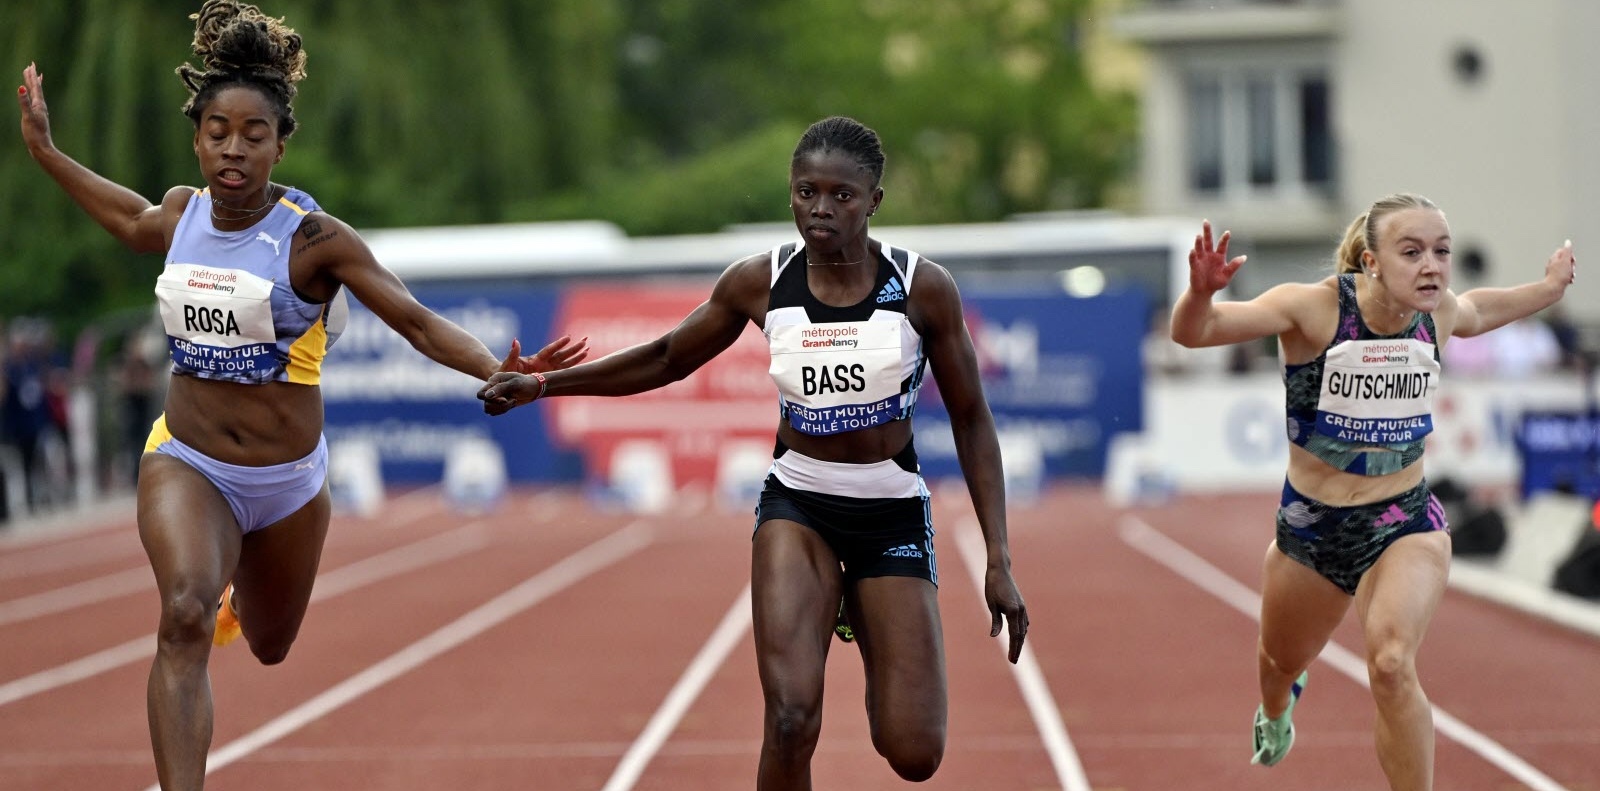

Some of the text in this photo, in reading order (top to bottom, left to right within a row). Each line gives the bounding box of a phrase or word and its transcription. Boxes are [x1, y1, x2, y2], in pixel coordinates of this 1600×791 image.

[190, 270, 237, 283] métropole
[188, 279, 236, 294] GrandNancy
[184, 304, 241, 337] ROSA
[801, 326, 858, 340] métropole
[175, 339, 270, 360] CRÉDIT MUTUEL
[802, 338, 859, 348] GrandNancy
[1363, 343, 1409, 354] métropole
[183, 356, 255, 371] ATHLÉ TOUR
[1362, 355, 1410, 364] GrandNancy
[802, 363, 866, 396] BASS
[1328, 371, 1431, 400] GUTSCHMIDT
[791, 400, 892, 421] CRÉDIT MUTUEL
[800, 415, 879, 433] ATHLÉ TOUR
[1325, 414, 1425, 431] CRÉDIT MUTUEL
[1338, 429, 1413, 443] ATHLÉ TOUR
